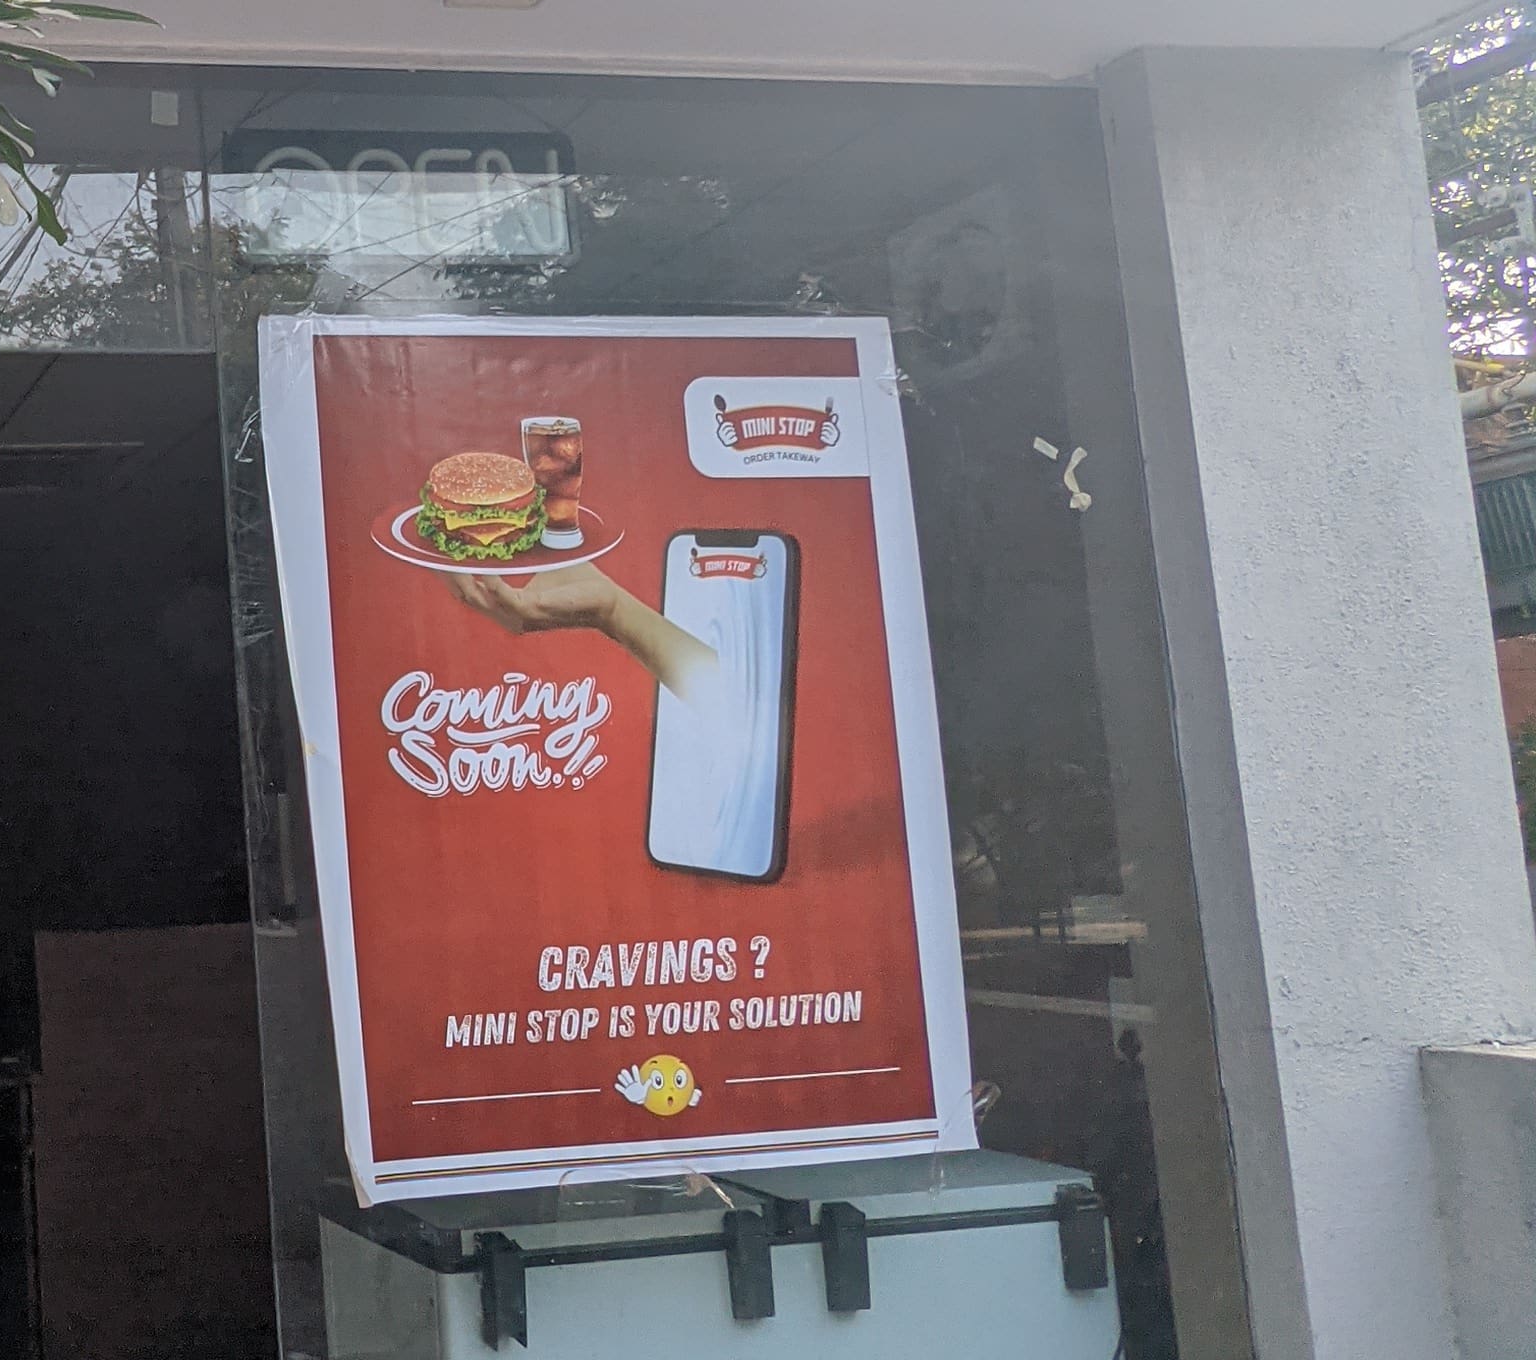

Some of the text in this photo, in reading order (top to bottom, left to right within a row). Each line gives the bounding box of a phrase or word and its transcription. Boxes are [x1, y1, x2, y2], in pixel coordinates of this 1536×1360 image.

[741, 417, 816, 439] MINI STOP
[743, 452, 775, 465] ORDER
[381, 671, 611, 758] Coming
[538, 938, 737, 992] CRAVINGS
[445, 990, 863, 1048] MINI STOP IS YOUR SOLUTION
